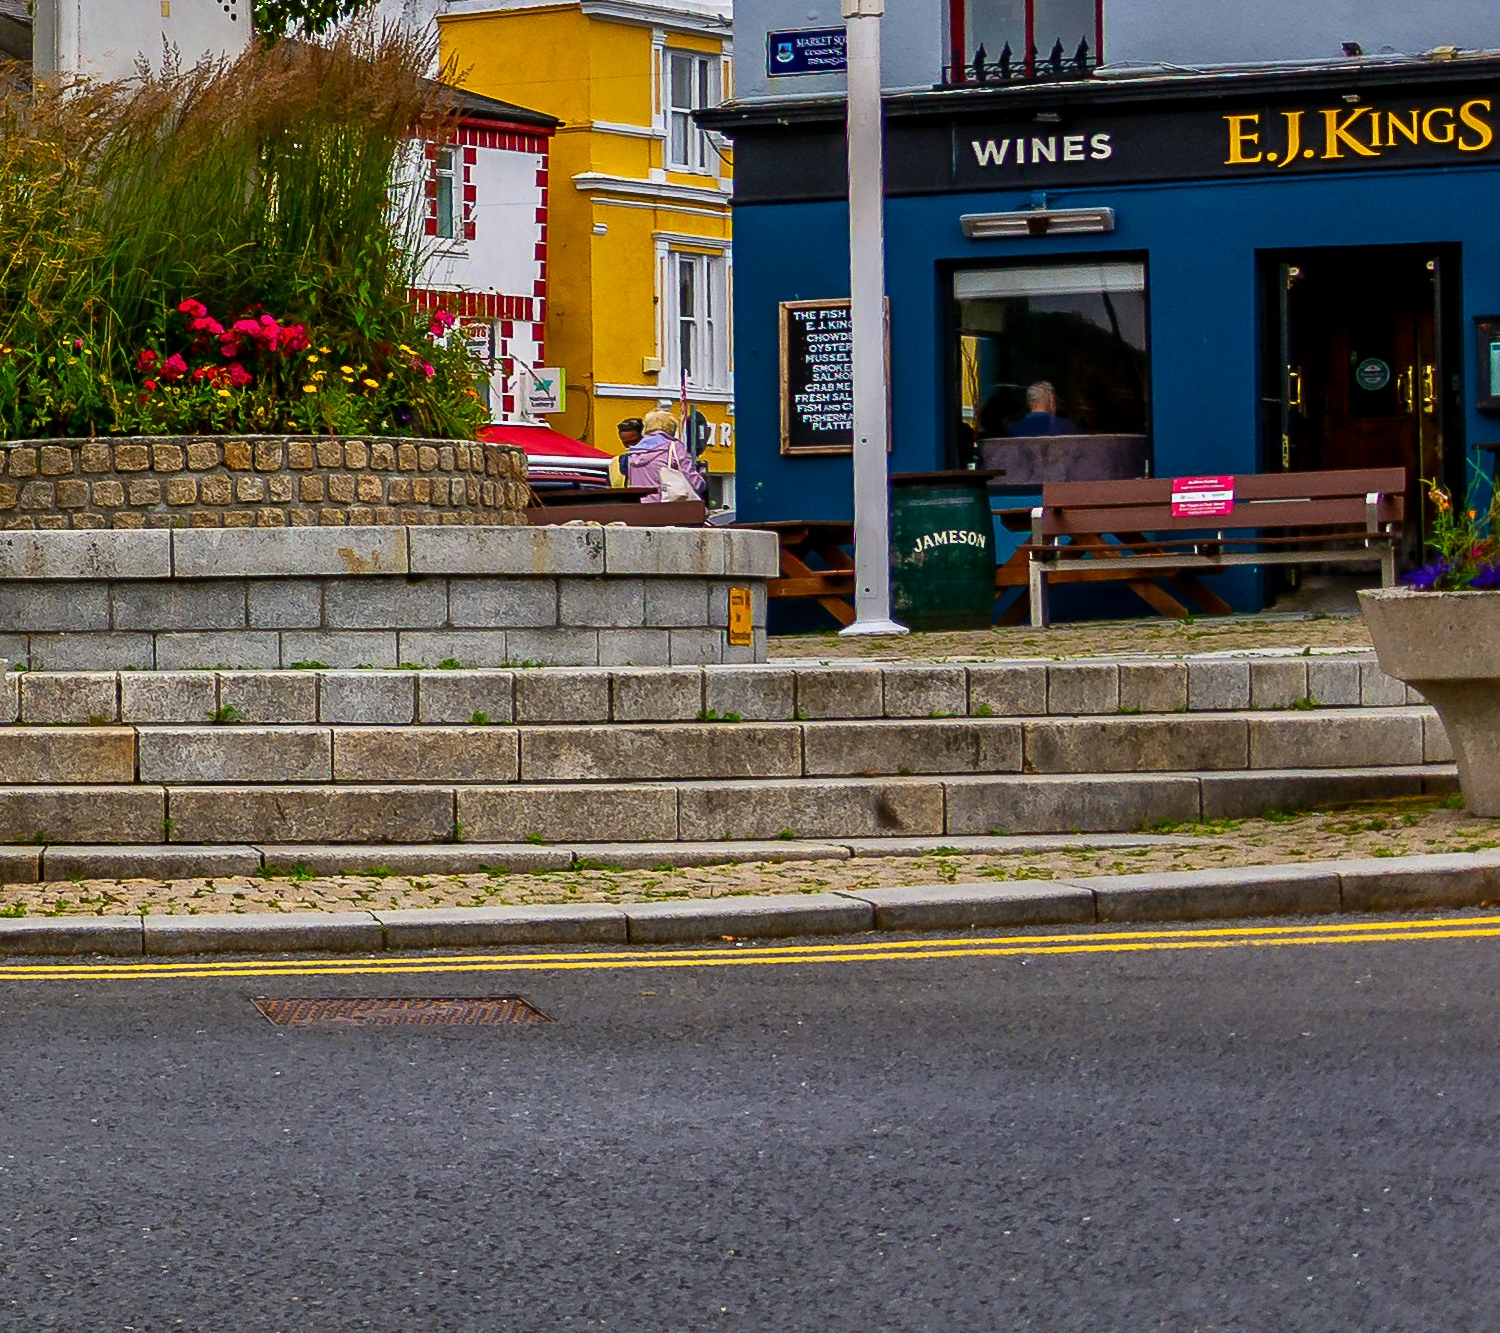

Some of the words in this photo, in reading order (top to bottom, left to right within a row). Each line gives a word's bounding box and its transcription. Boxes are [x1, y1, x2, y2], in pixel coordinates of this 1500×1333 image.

[796, 36, 832, 47] MARKET
[971, 132, 1115, 167] WINES
[793, 311, 817, 320] THE
[819, 309, 847, 319] FISH
[805, 353, 850, 363] MUSSEL
[812, 364, 851, 373] SMOKE
[812, 372, 852, 382] SALMO
[804, 383, 834, 392] CRAB
[794, 393, 831, 403] FRESH
[796, 404, 822, 413] FISH
[802, 413, 853, 423] FISHERMA
[812, 421, 852, 431] PLATTE
[913, 529, 986, 553] JAMESON
